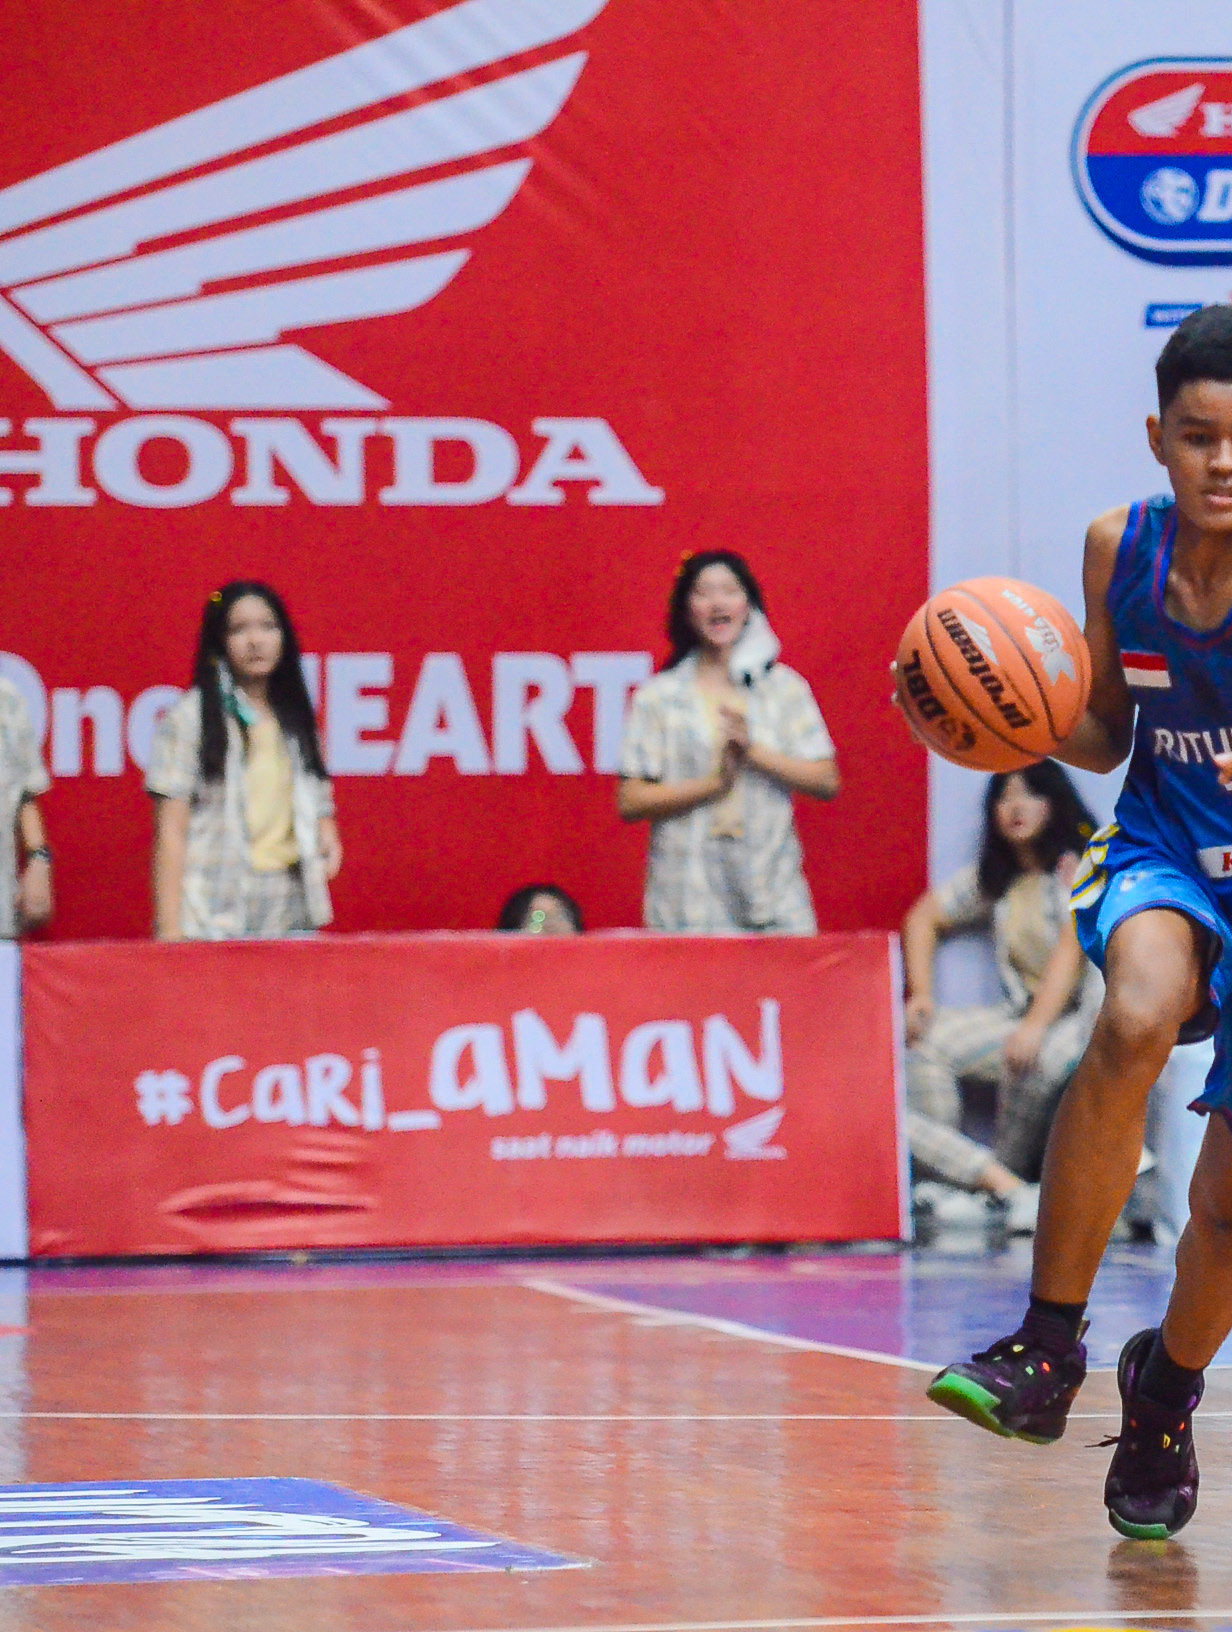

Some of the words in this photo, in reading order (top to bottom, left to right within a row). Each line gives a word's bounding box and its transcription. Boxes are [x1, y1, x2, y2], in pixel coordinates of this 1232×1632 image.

[301, 651, 655, 777] EART
[903, 648, 948, 722] DBL
[937, 608, 1033, 729] proteam
